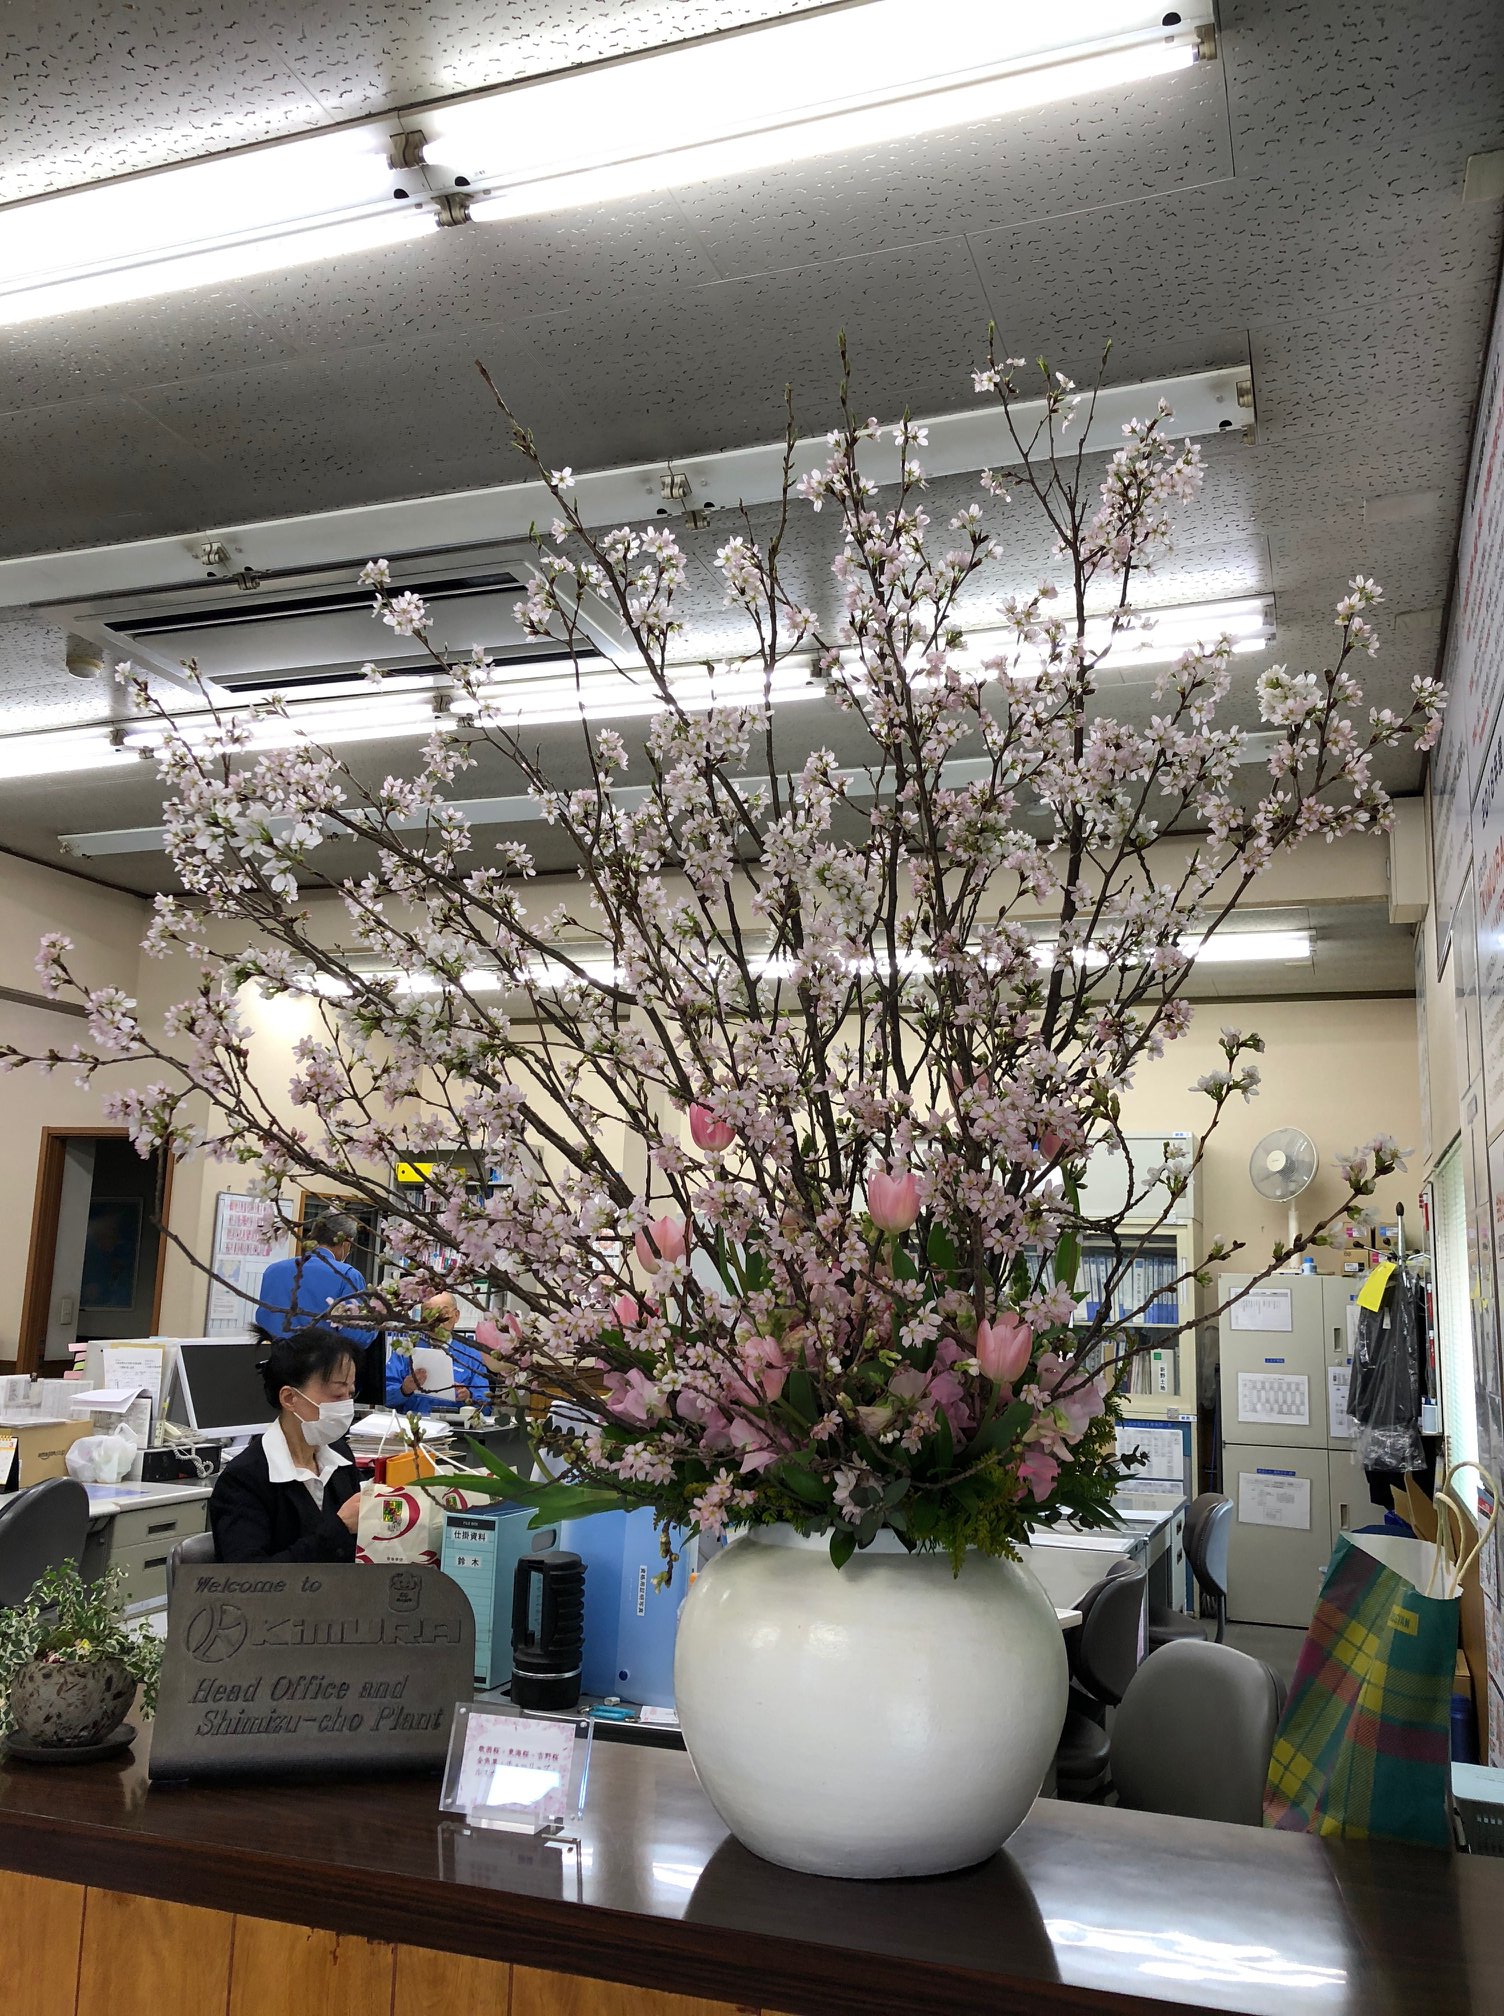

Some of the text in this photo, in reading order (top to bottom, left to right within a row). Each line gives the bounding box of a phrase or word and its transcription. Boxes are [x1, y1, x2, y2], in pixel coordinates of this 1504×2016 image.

[9, 1441, 14, 1449] 3
[454, 1530, 486, 1542] 仕掛資料
[194, 1576, 322, 1594] Welcome to
[188, 1674, 409, 1704] Head Office and
[195, 1705, 445, 1736] Shimizu-cho Plant
